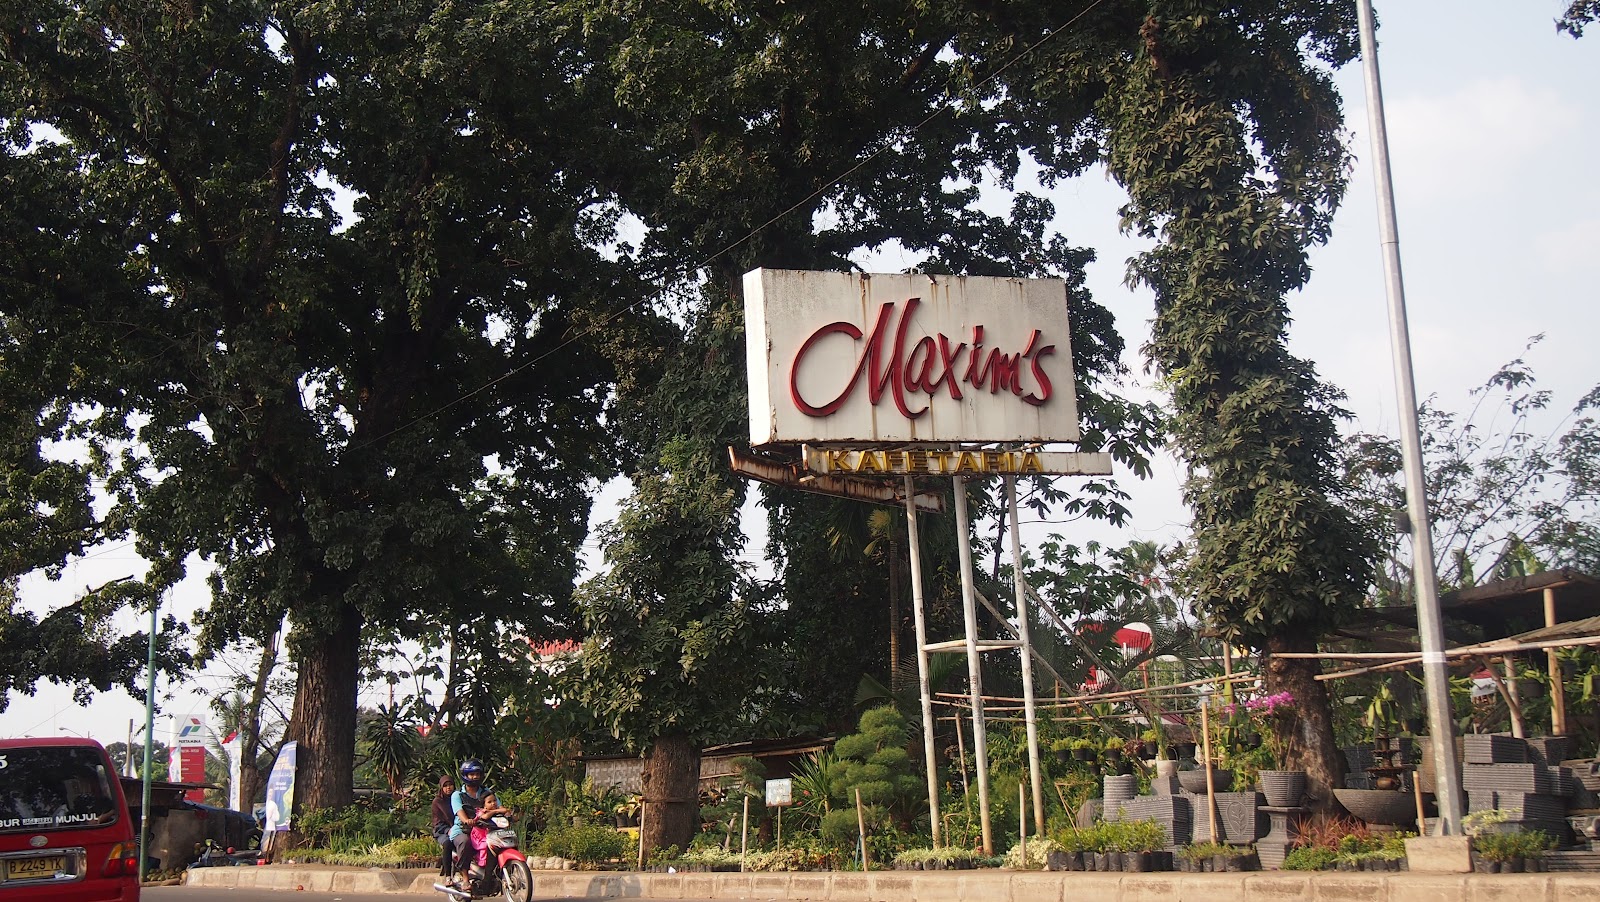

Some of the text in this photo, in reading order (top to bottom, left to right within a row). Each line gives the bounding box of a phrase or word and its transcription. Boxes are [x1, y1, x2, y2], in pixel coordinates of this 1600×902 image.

[790, 297, 1056, 419] Maxim's
[826, 450, 1043, 473] KAFETARIA
[56, 813, 98, 824] MUNJUL
[10, 861, 16, 873] B
[20, 859, 46, 872] 2249
